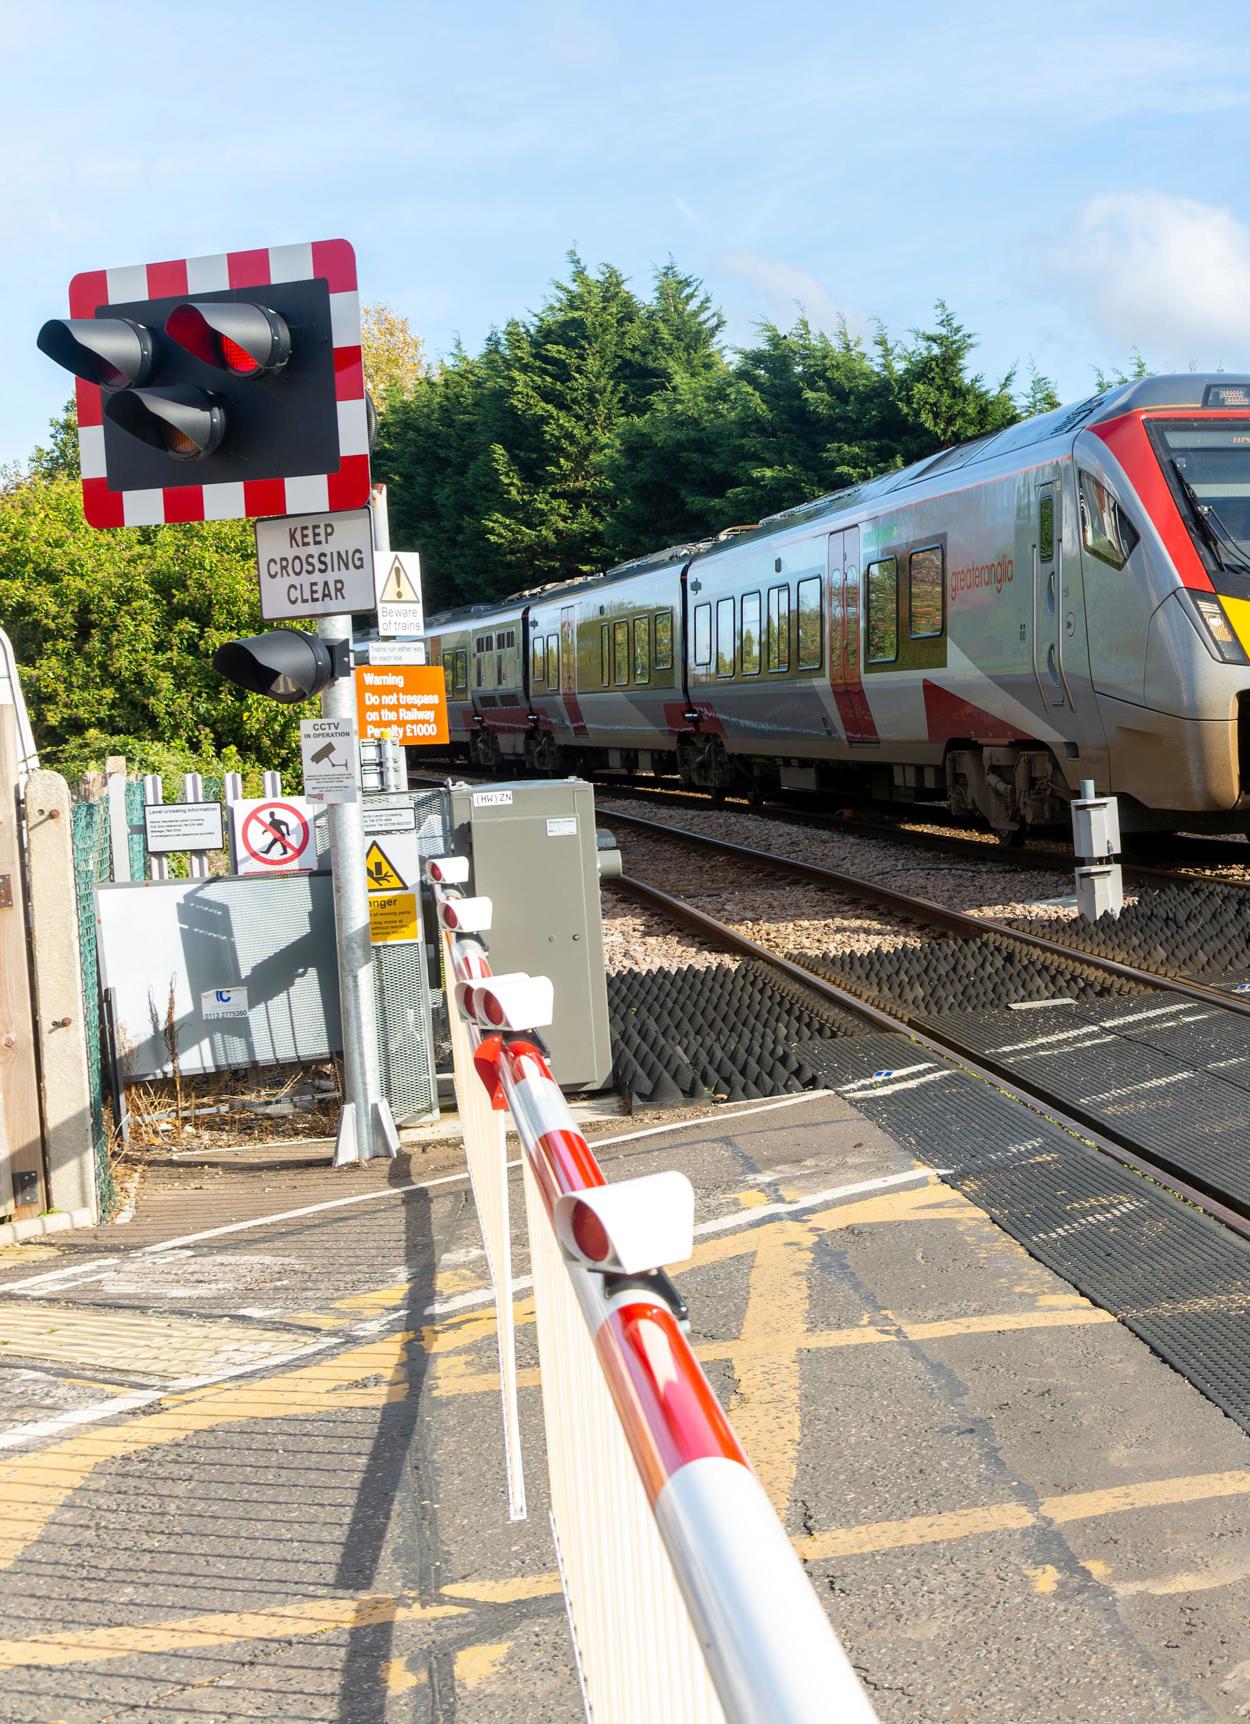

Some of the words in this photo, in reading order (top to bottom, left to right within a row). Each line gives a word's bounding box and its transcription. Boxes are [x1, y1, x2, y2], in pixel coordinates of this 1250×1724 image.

[289, 523, 335, 549] KEEP
[267, 548, 364, 579] CROSSING
[951, 553, 1014, 602] greateranglia
[287, 579, 346, 605] CLEAR
[381, 606, 418, 618] Beware
[382, 621, 393, 631] of
[394, 621, 421, 631] trains
[370, 645, 387, 653] Trains
[363, 672, 404, 688] Warning
[365, 692, 380, 705] Do
[381, 692, 398, 705] not
[399, 692, 440, 707] trespass
[366, 711, 379, 722] on
[381, 708, 397, 721] the
[399, 708, 435, 722] Railway
[312, 722, 340, 731] CCTV
[405, 724, 437, 737] £1000
[312, 731, 350, 739] OPERATION
[368, 898, 398, 909] anger
